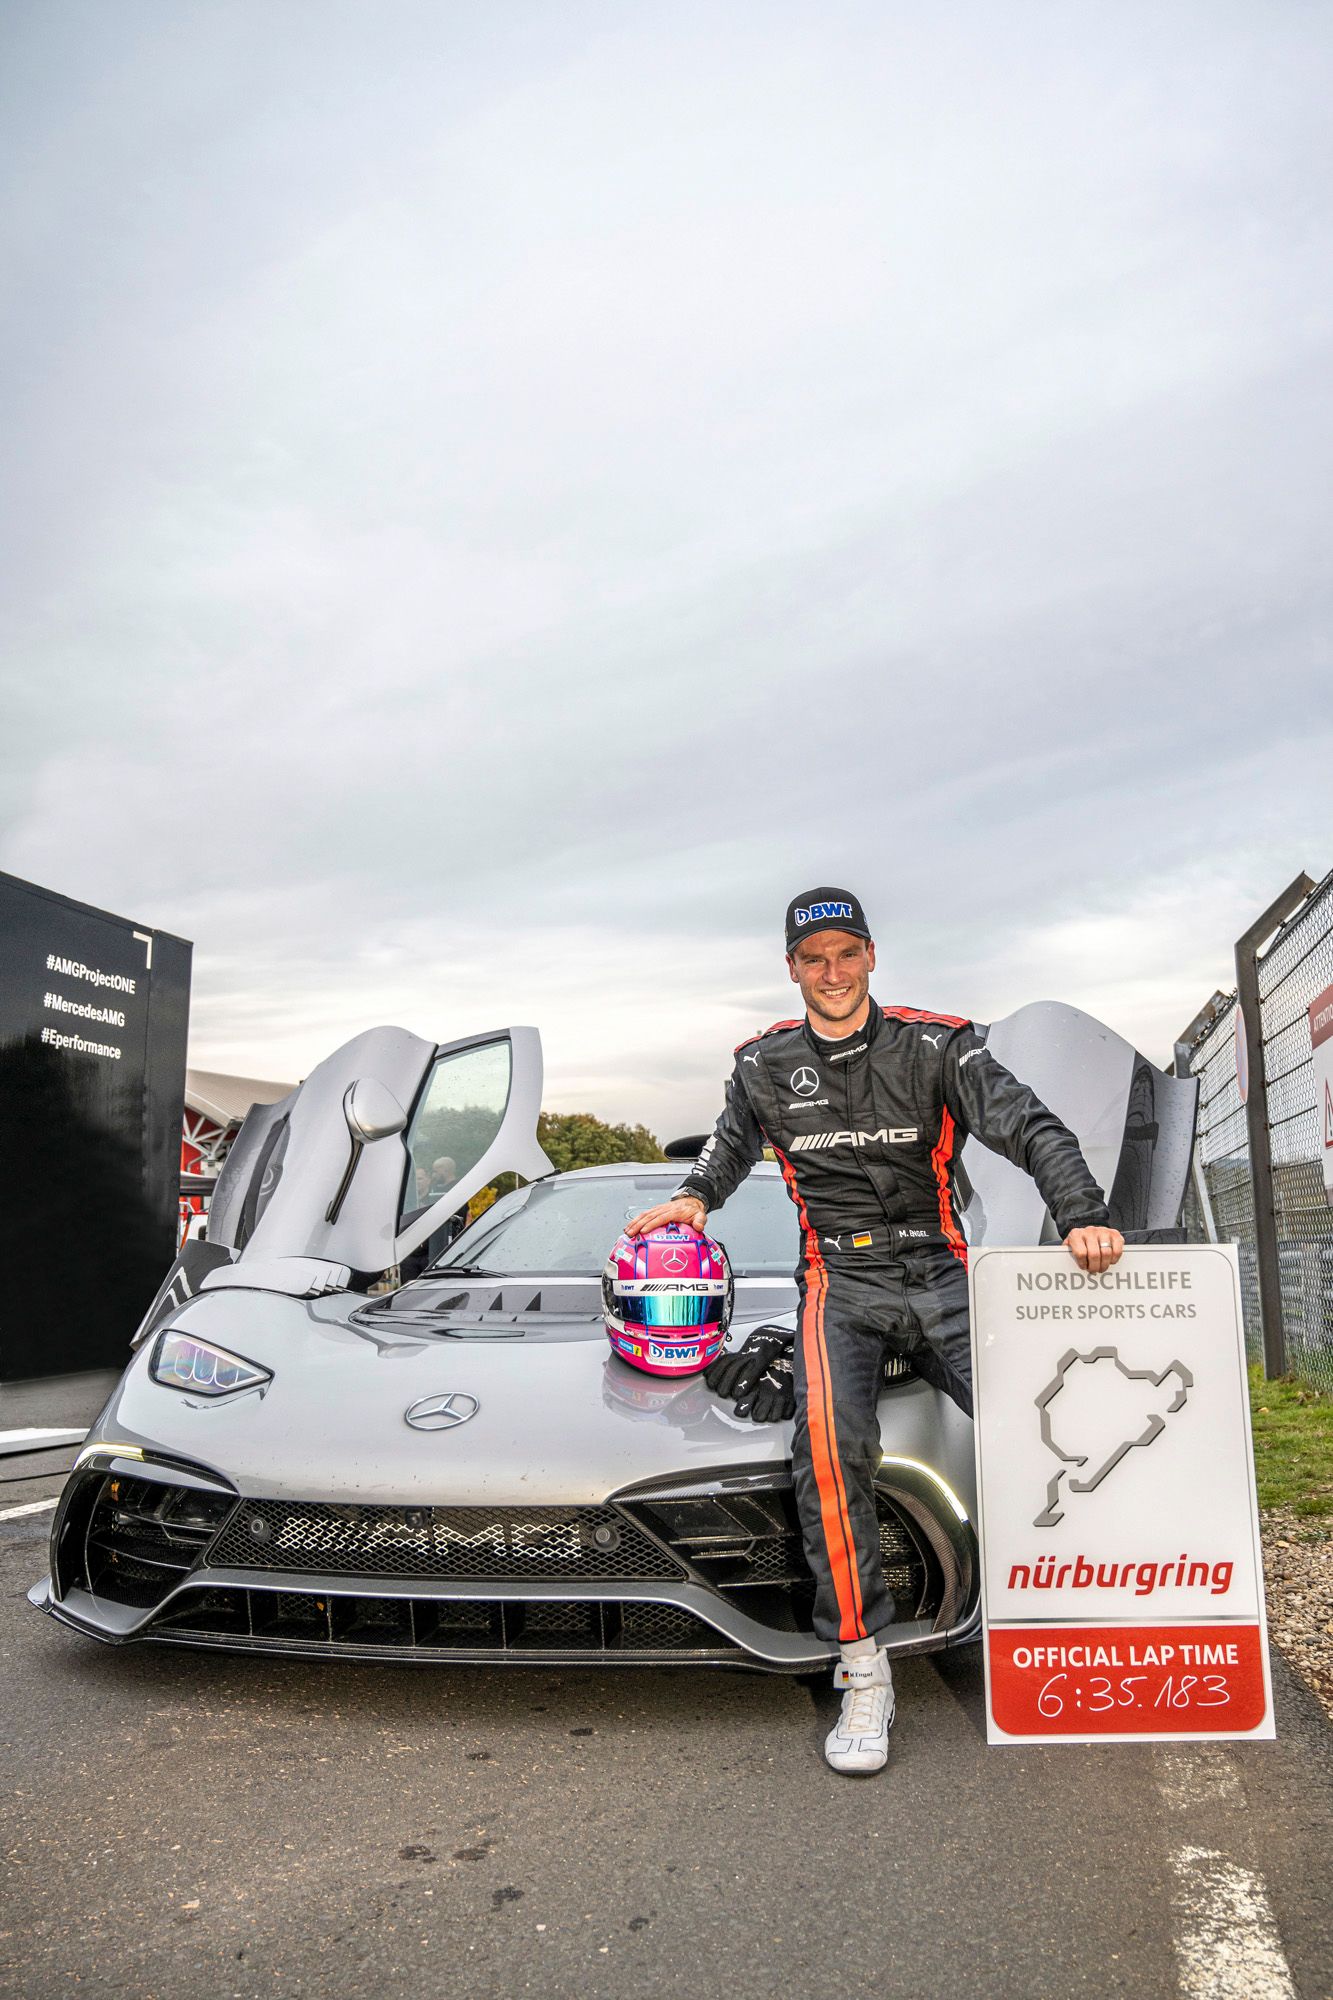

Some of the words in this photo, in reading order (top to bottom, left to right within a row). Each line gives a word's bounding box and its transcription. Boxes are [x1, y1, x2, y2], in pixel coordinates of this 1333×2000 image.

[810, 902, 853, 921] BWT
[46, 954, 136, 994] #AMGProjectONE
[43, 992, 125, 1027] #MercedesAMG
[41, 1027, 121, 1059] #Eperformance
[842, 1043, 868, 1057] AMG
[802, 1099, 829, 1108] AMG
[828, 1128, 918, 1148] AMG
[664, 1284, 709, 1292] AMG
[1017, 1271, 1192, 1290] NORDSCHLEIFE
[1015, 1305, 1073, 1320] SUPER
[1077, 1304, 1146, 1319] SPORTS
[1150, 1303, 1197, 1318] CARS
[664, 1346, 699, 1359] BWT
[1007, 1553, 1234, 1596] nürburgring
[1012, 1646, 1123, 1669] OFFICIAL
[1129, 1645, 1175, 1667] LAP
[1179, 1644, 1239, 1666] TIME
